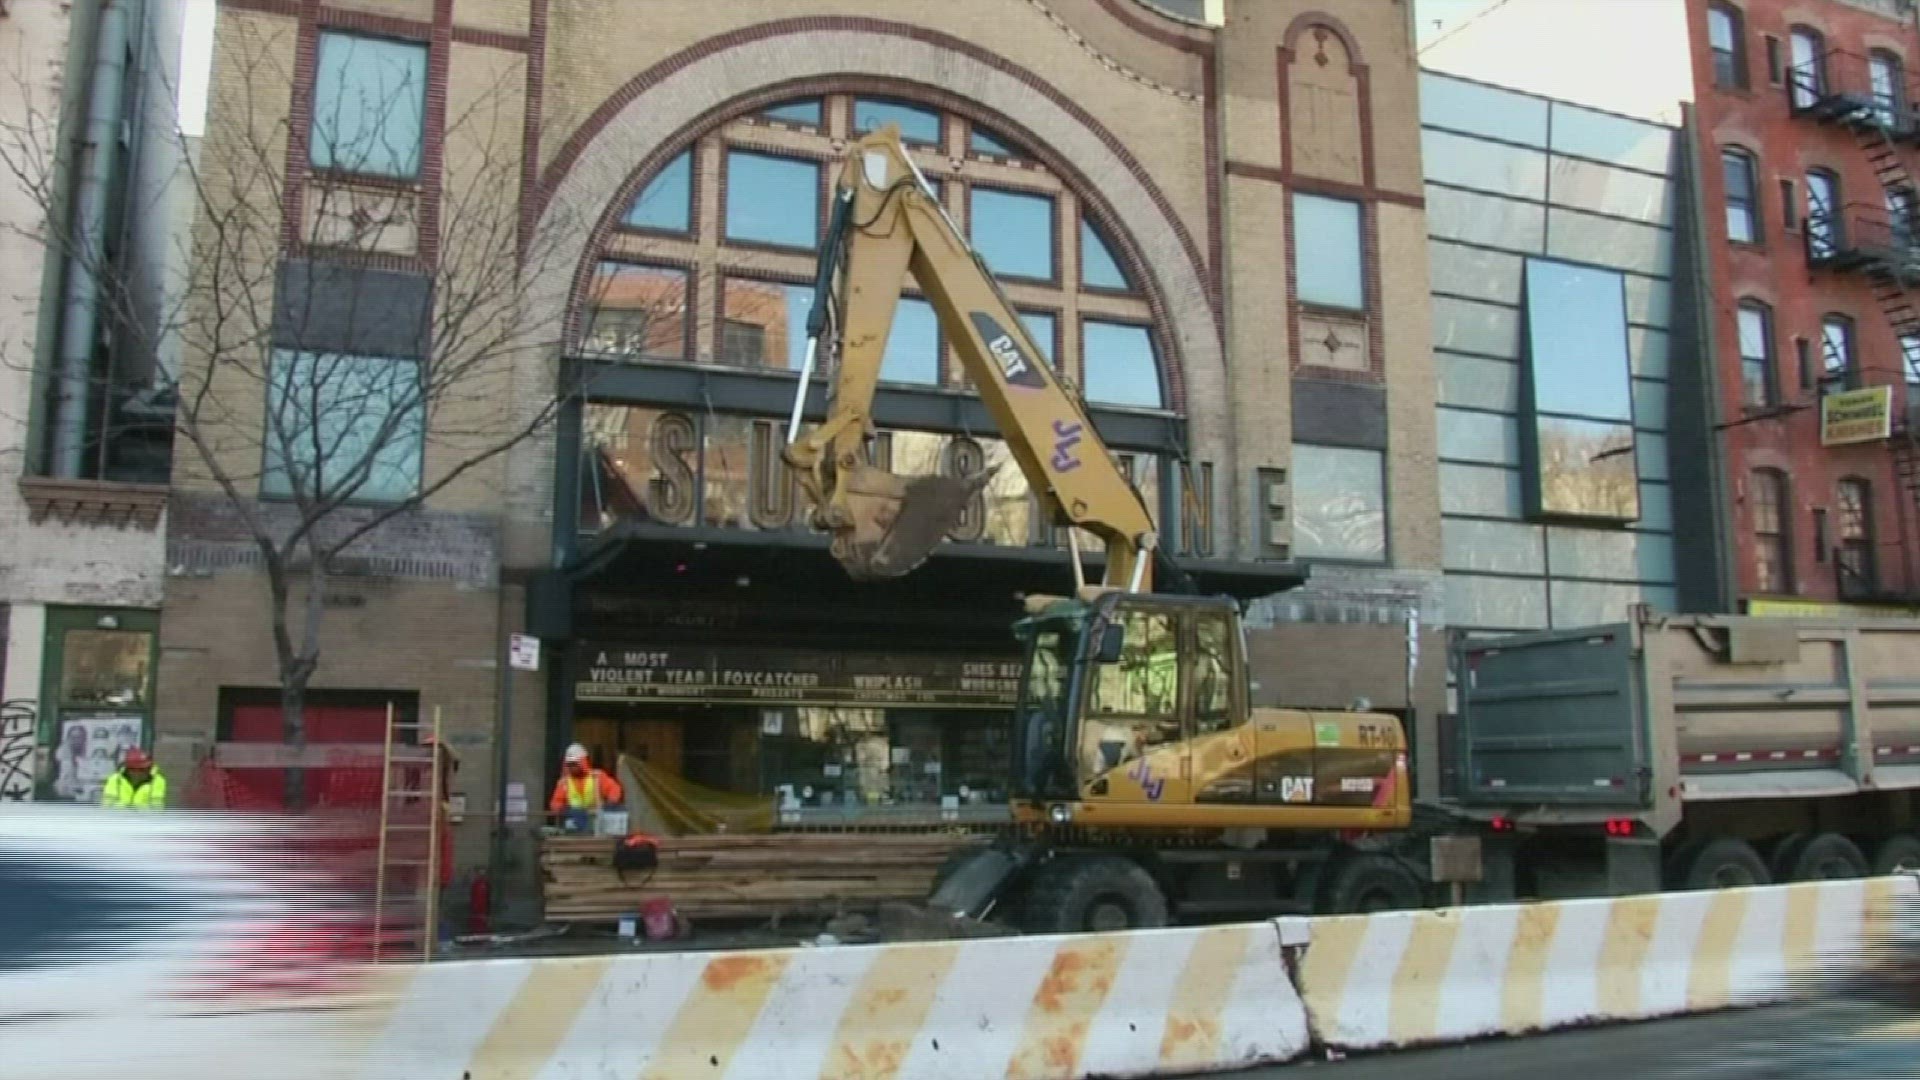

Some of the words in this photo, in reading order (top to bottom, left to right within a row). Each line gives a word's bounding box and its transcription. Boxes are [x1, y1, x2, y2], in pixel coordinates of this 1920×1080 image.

[989, 334, 1027, 378] CAT
[647, 411, 1292, 564] SUSNE
[597, 652, 608, 666] A
[624, 652, 669, 667] MOST
[589, 667, 653, 683] VIOLENT
[665, 668, 705, 684] YEAR
[724, 671, 818, 687] FOXCATCHER
[854, 675, 922, 690] WHIPLASH
[1281, 776, 1313, 802] CAT
